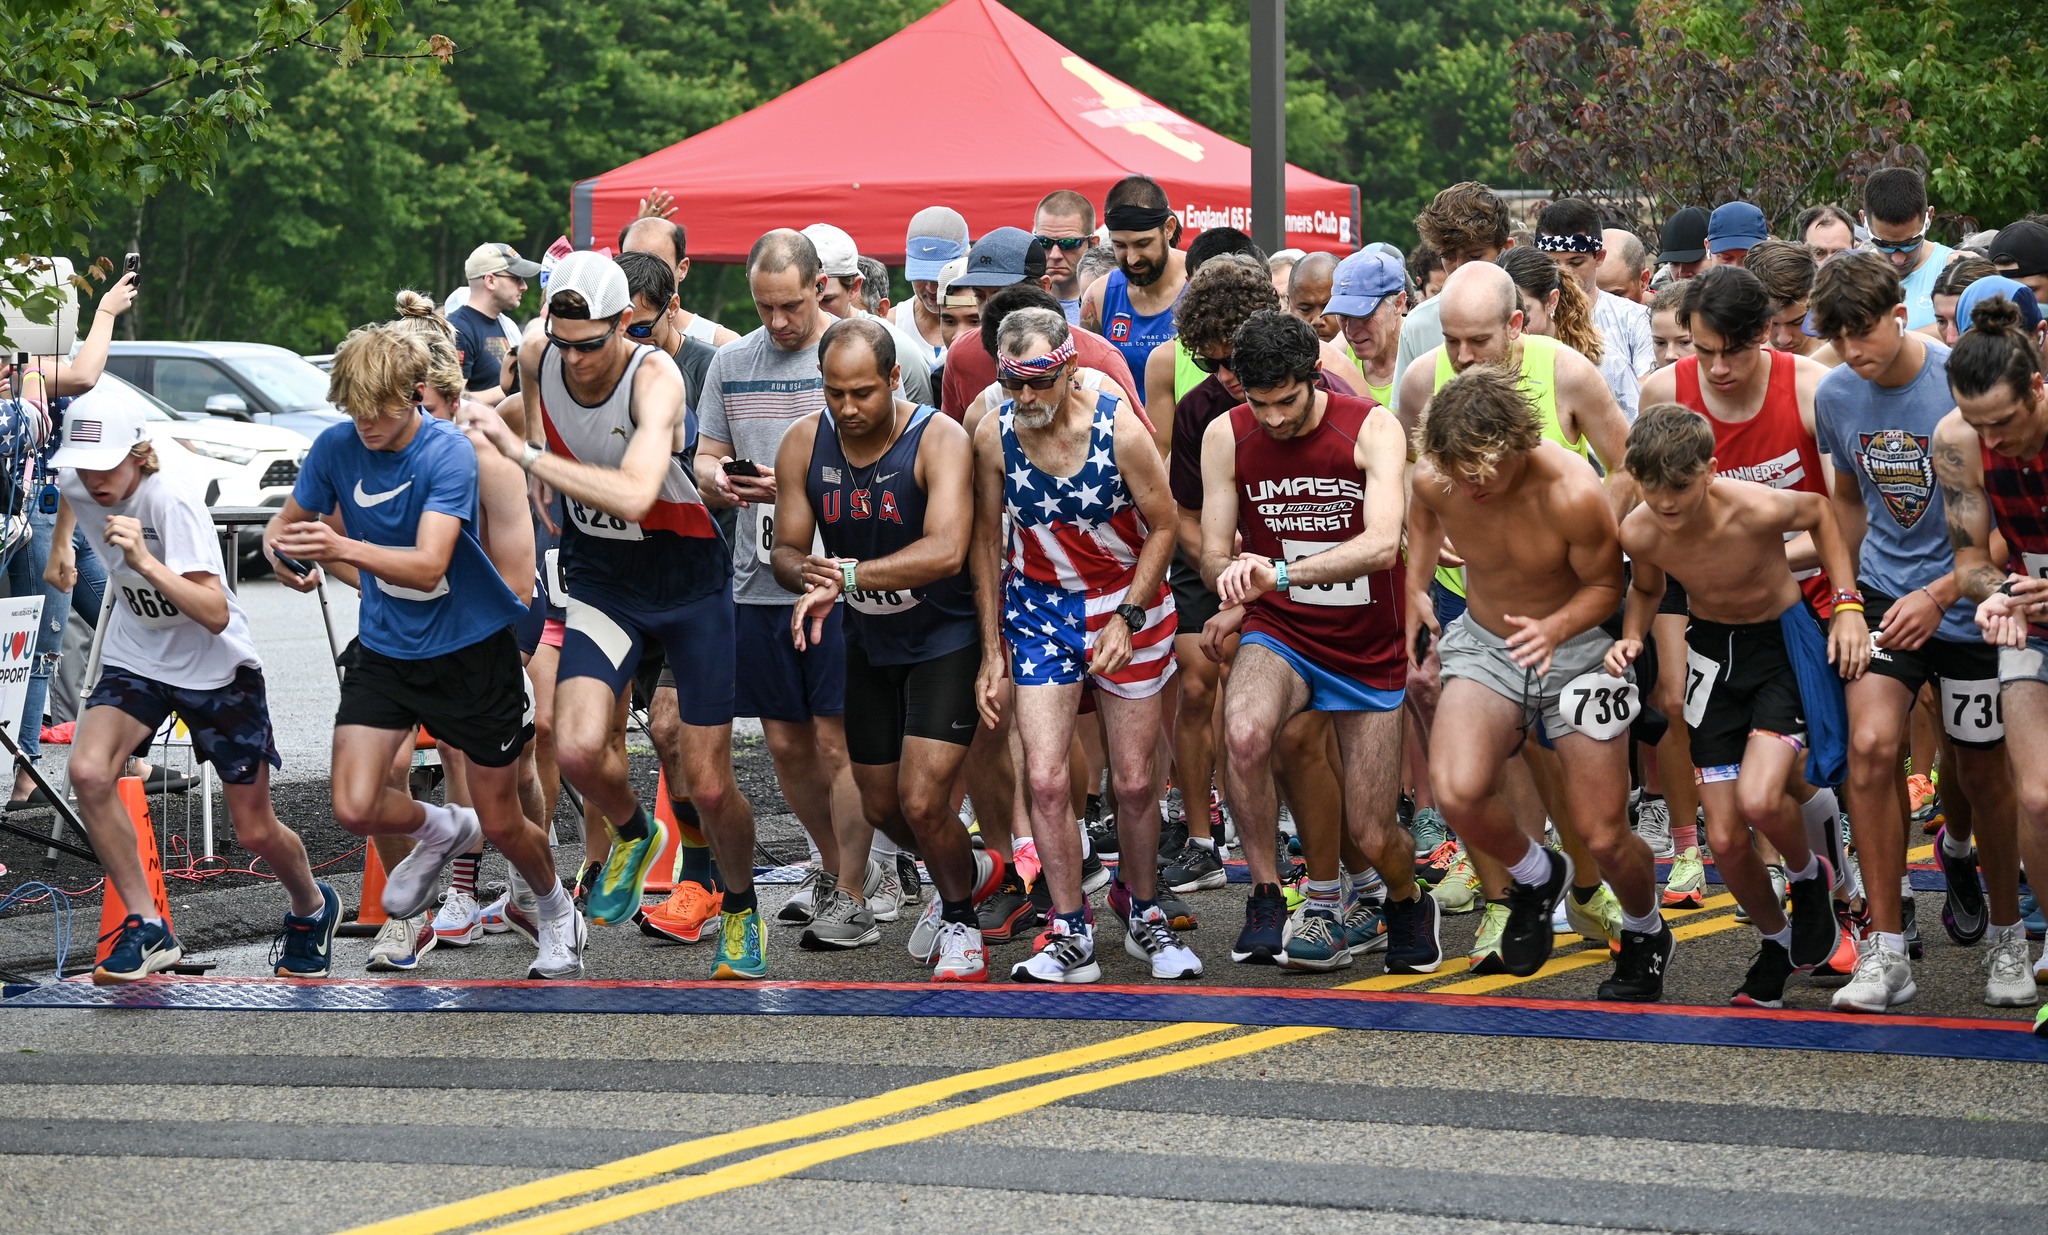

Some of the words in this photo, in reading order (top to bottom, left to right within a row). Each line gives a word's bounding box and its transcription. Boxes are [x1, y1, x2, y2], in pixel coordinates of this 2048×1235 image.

[1186, 204, 1230, 232] England
[1231, 207, 1246, 230] 65
[1314, 210, 1338, 234] Club
[771, 382, 787, 391] RUN
[1870, 458, 1923, 477] NATIONAL
[1245, 477, 1364, 502] UMASS
[823, 489, 904, 525] USA
[1285, 502, 1346, 513] MINUTEMEN
[1264, 514, 1353, 532] AMHERST
[122, 585, 179, 619] 868
[1573, 686, 1631, 726] 738
